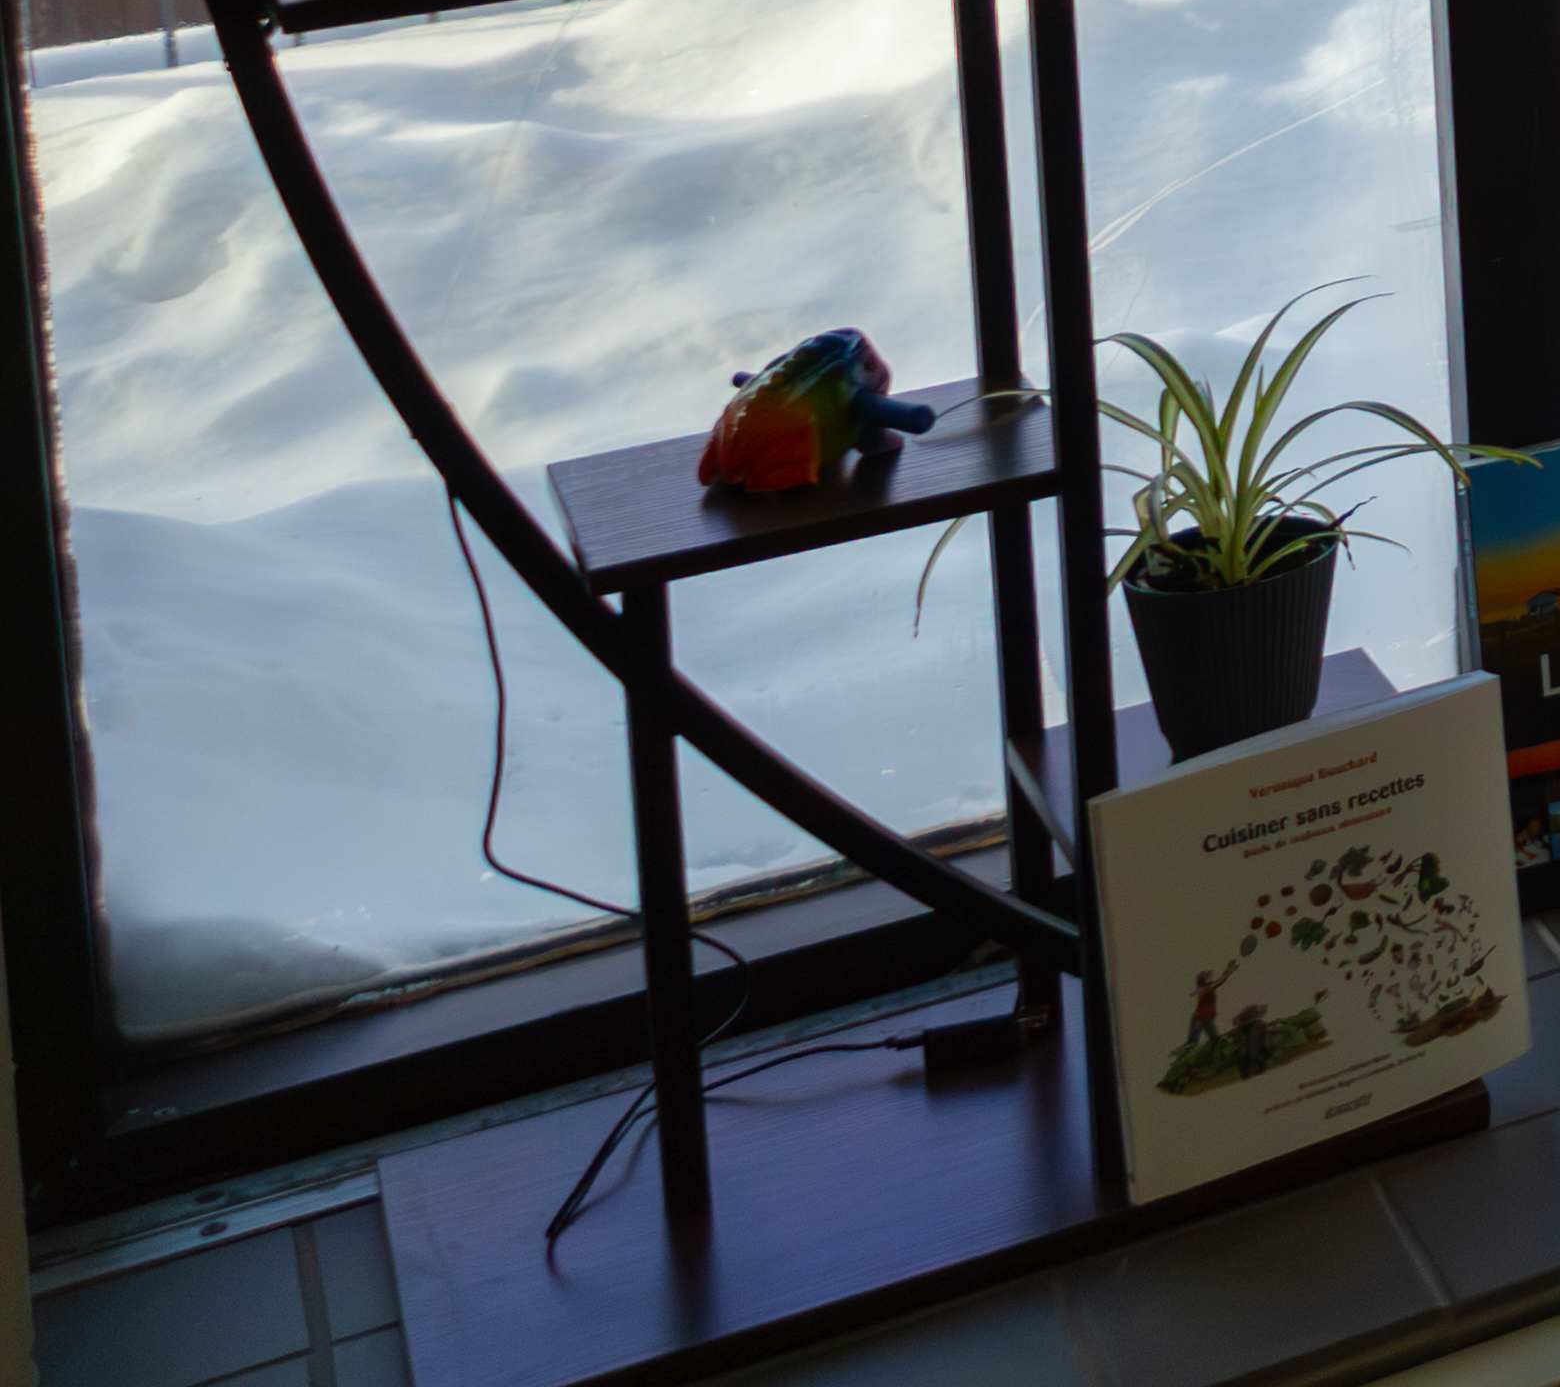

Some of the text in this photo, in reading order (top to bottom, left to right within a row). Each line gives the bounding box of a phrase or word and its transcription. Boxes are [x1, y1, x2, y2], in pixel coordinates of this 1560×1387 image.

[1202, 774, 1425, 853] Cuisiner sans recettes
